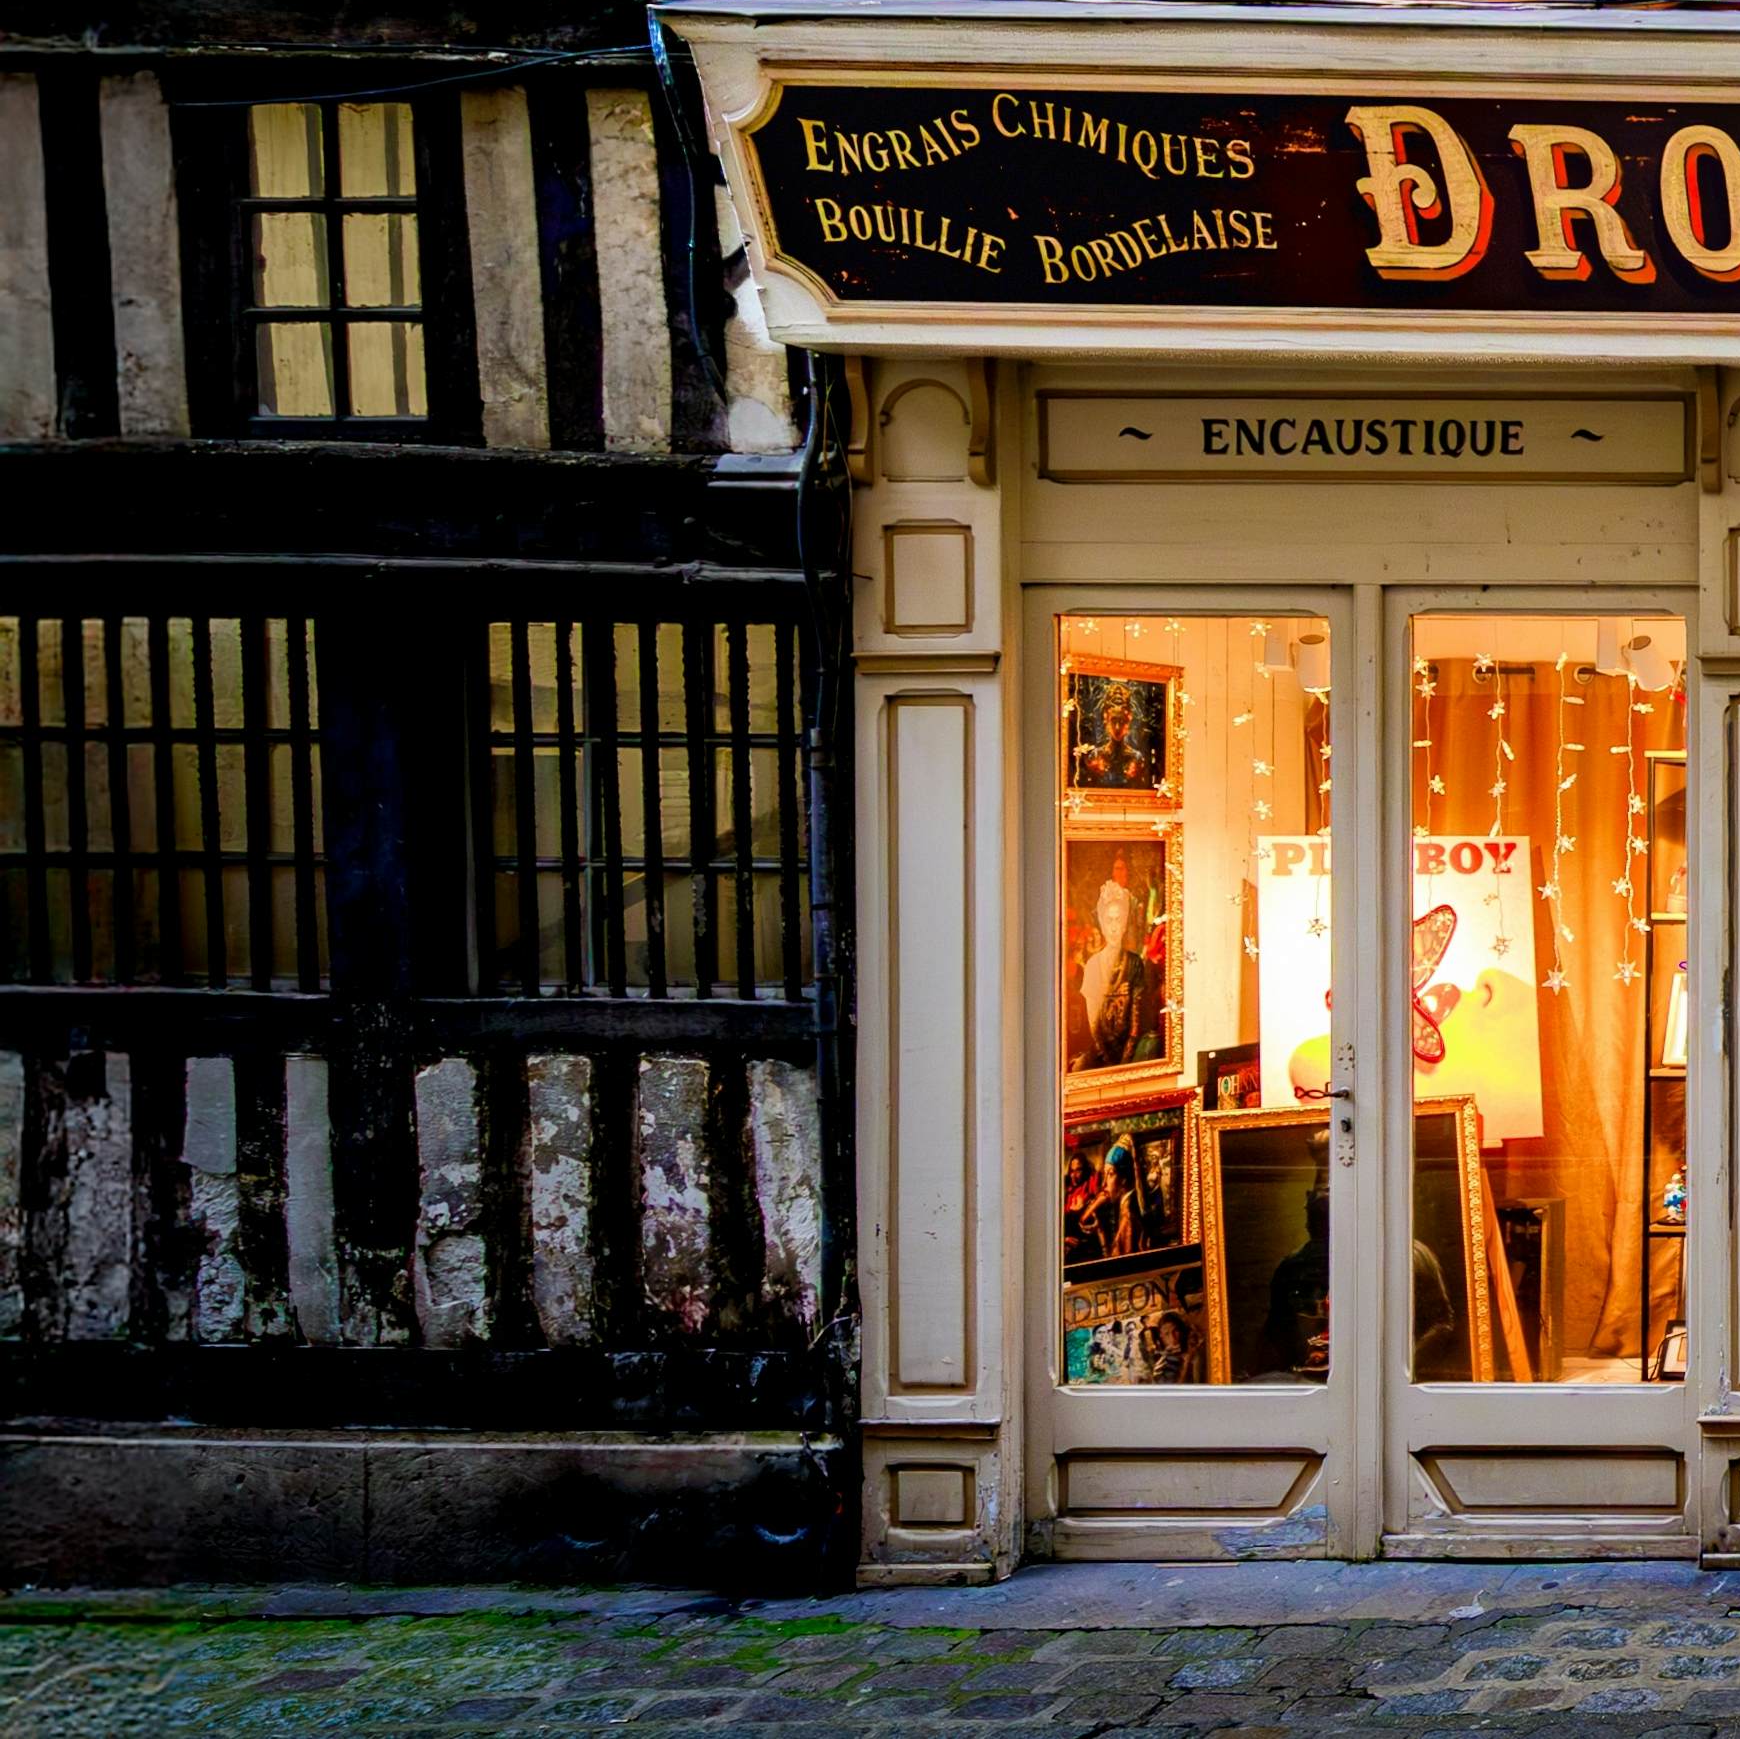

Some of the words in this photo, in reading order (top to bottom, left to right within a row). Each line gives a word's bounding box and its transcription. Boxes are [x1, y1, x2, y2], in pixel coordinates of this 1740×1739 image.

[797, 108, 981, 177] ENGRAIS
[991, 92, 1256, 181] CHIMIQUES
[813, 197, 1006, 275] BOUILLIE
[1034, 208, 1279, 284] BORDELAISE
[1201, 417, 1525, 460] ENCAUSTIQUE
[1271, 842, 1518, 876] PLBOY
